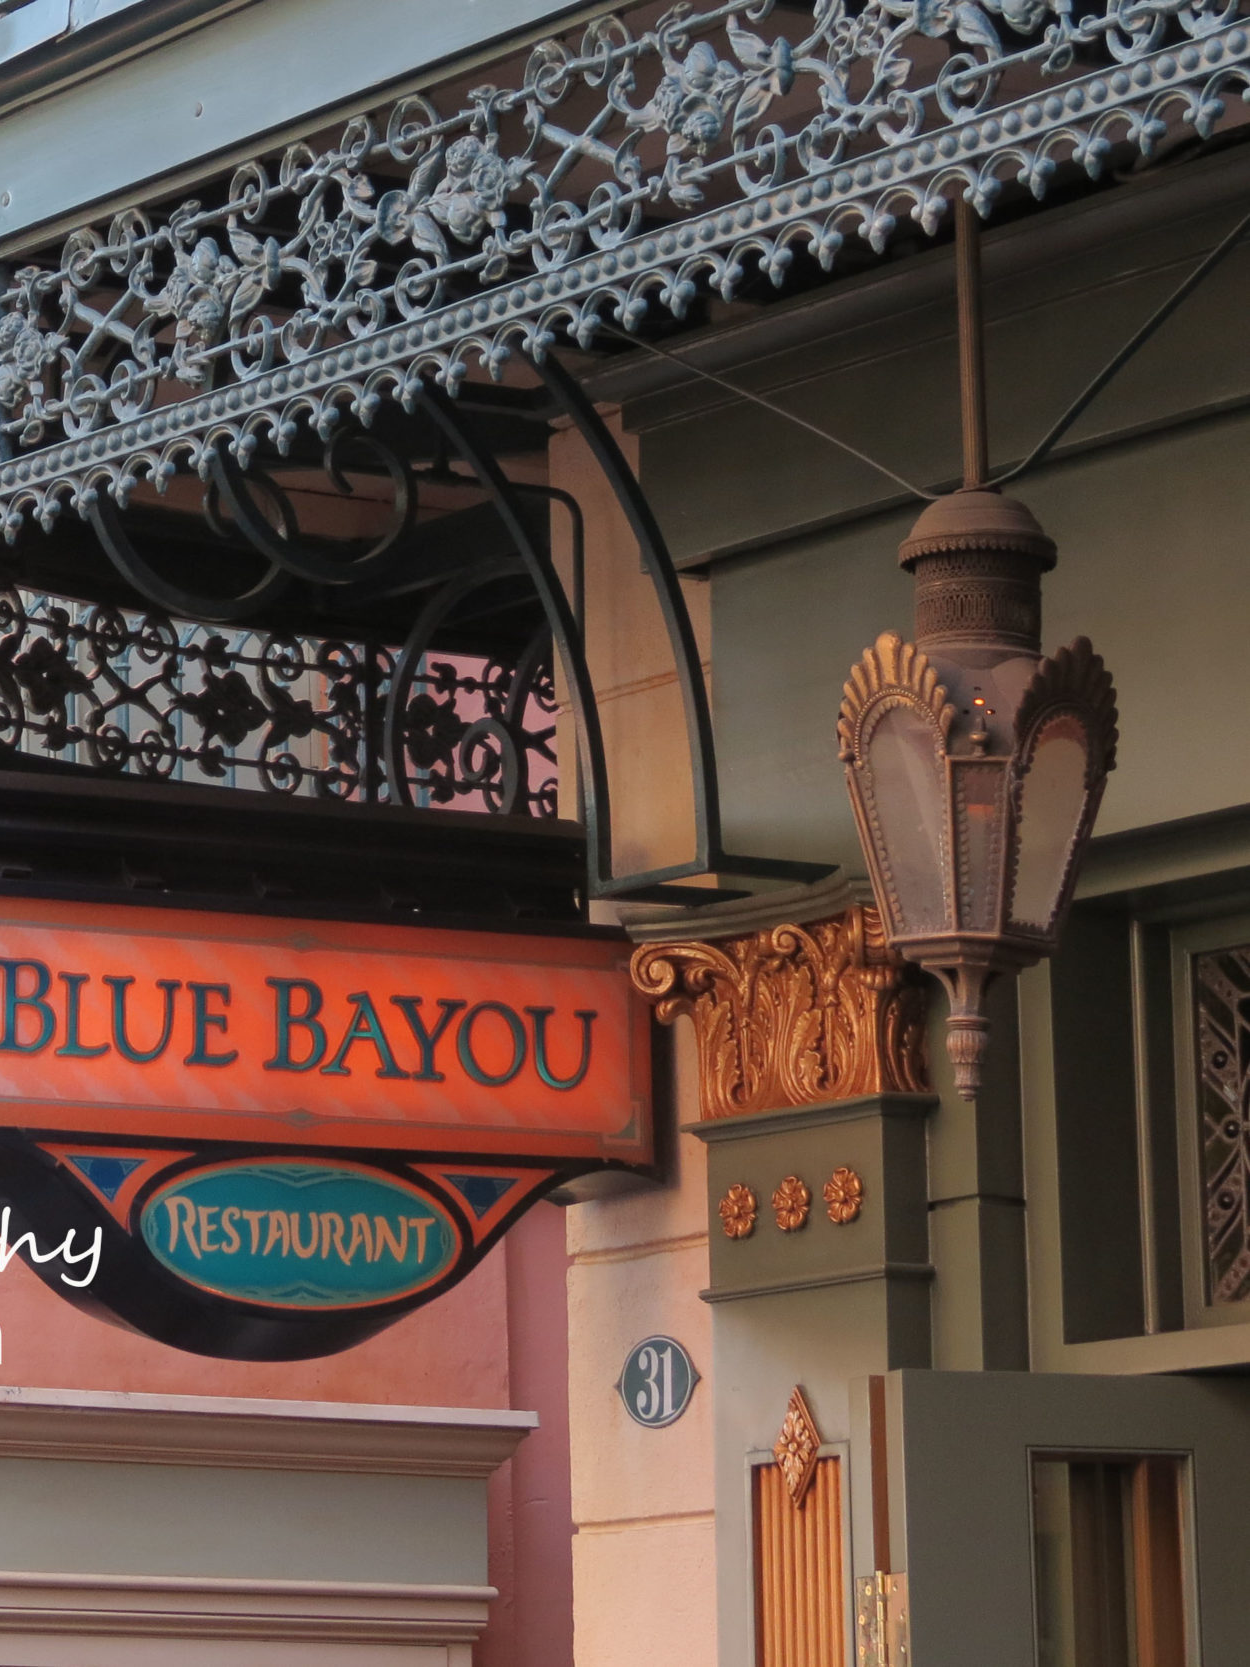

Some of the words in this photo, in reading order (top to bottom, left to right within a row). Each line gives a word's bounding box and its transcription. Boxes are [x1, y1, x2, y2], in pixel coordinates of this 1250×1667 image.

[263, 975, 598, 1091] BAYOU
[166, 1194, 437, 1265] RESTAURANT
[637, 1345, 676, 1419] 31
